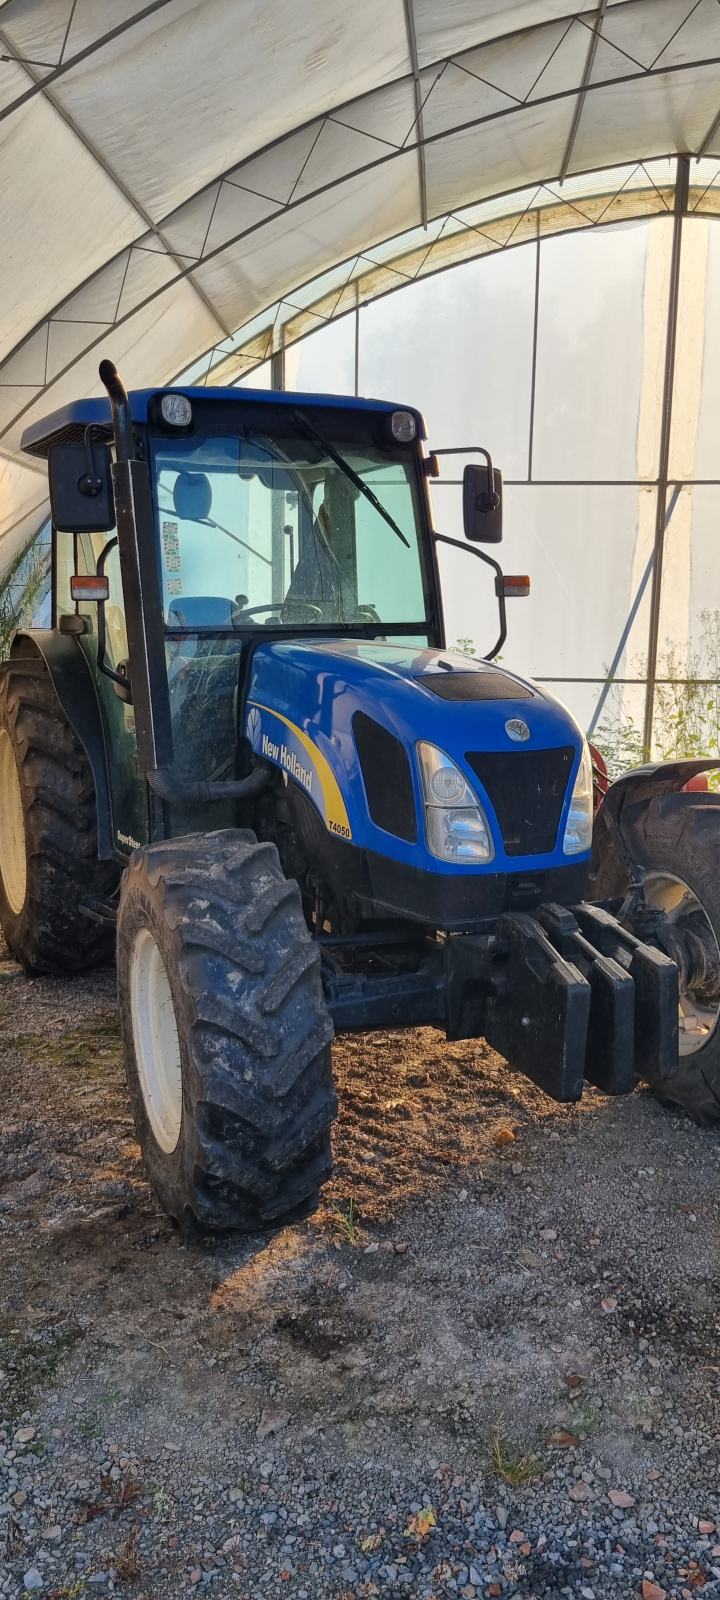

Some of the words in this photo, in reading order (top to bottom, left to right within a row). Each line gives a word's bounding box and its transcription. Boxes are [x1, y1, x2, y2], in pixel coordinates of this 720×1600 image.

[262, 734, 280, 761] New
[280, 744, 312, 792] Holland
[328, 820, 350, 838] T4050
